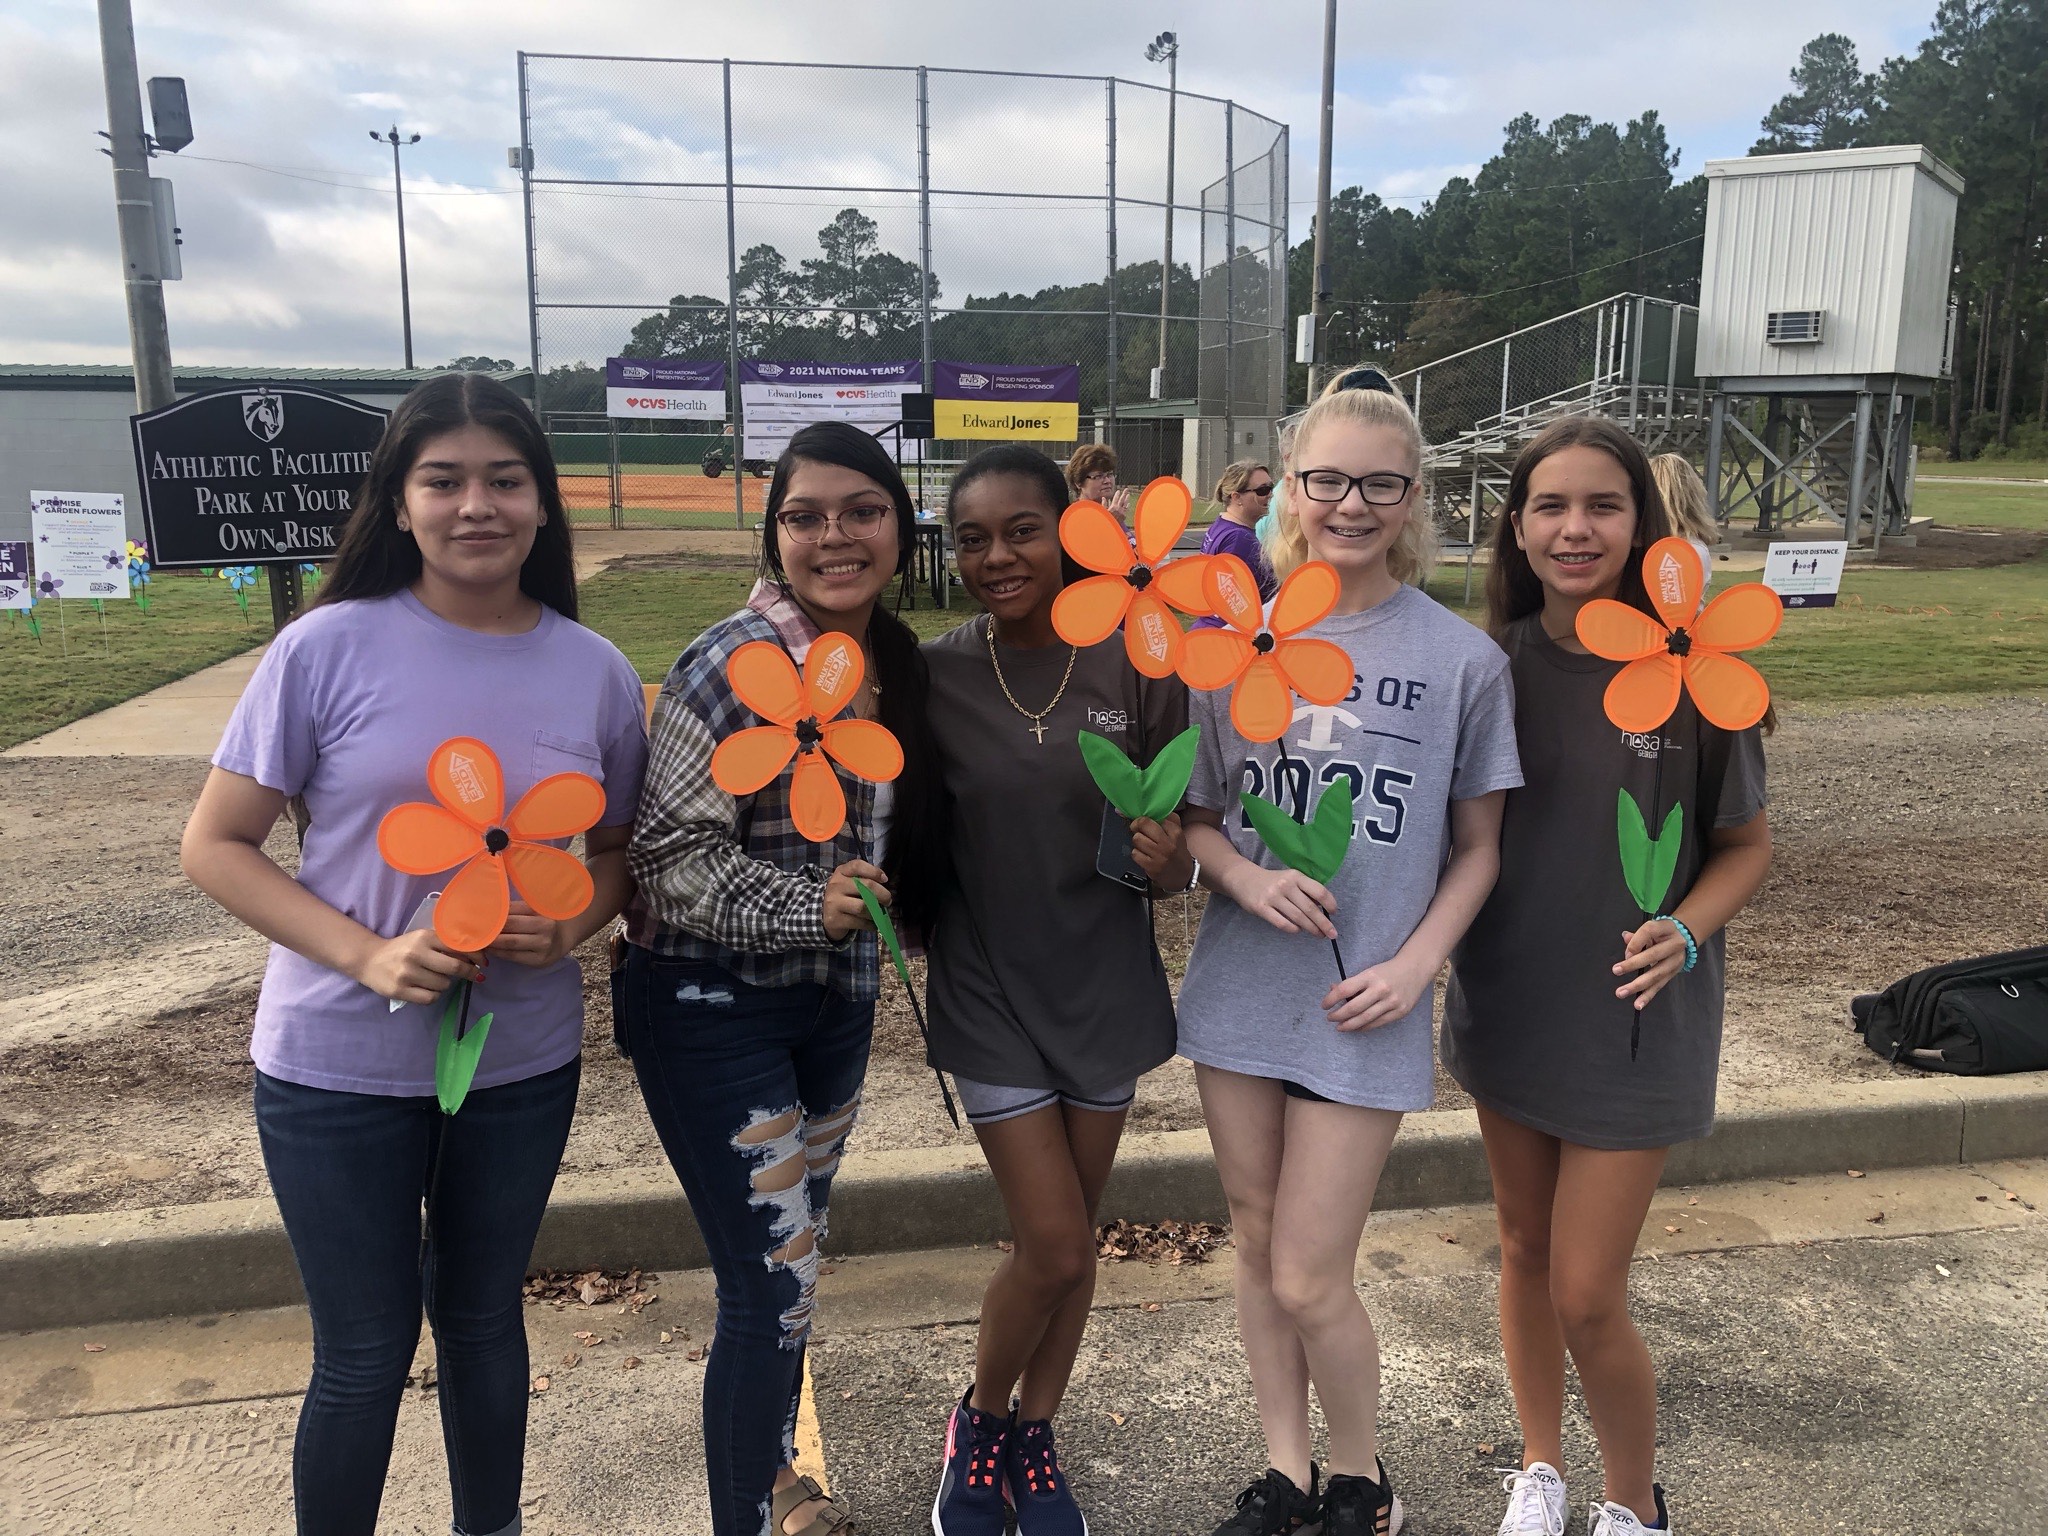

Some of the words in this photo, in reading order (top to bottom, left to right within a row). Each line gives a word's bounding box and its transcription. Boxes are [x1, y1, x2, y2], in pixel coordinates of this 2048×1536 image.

[789, 366, 815, 376] 2021
[817, 366, 869, 376] NATIONAL
[870, 366, 905, 376] TEAMS
[768, 388, 797, 399] Edward
[798, 390, 824, 400] Jones
[962, 413, 1009, 428] Edward
[1010, 415, 1050, 430] Jones
[151, 450, 262, 479] ATHLETIC
[269, 447, 372, 476] FACILITIE
[194, 486, 254, 515] PARK
[261, 491, 287, 513] AT
[291, 484, 351, 512] YOUR
[82, 508, 122, 516] FLOWERS
[218, 522, 276, 551] OWN
[283, 520, 337, 549] RISK
[1659, 569, 1667, 581] TO
[1666, 570, 1678, 602] END
[1219, 588, 1228, 600] TO
[1225, 584, 1246, 611] END
[1660, 581, 1670, 603] WALK
[1226, 599, 1240, 617] WALK
[1146, 614, 1160, 646] END
[1153, 612, 1165, 634] WALK
[1160, 633, 1168, 645] TO
[815, 665, 829, 687] WALK
[824, 656, 833, 667] TO
[822, 661, 840, 691] END
[1376, 676, 1426, 711] OF
[1104, 724, 1127, 733] GEORGIA
[450, 771, 460, 783] TO
[459, 769, 480, 800] END
[454, 783, 470, 805] WALK
